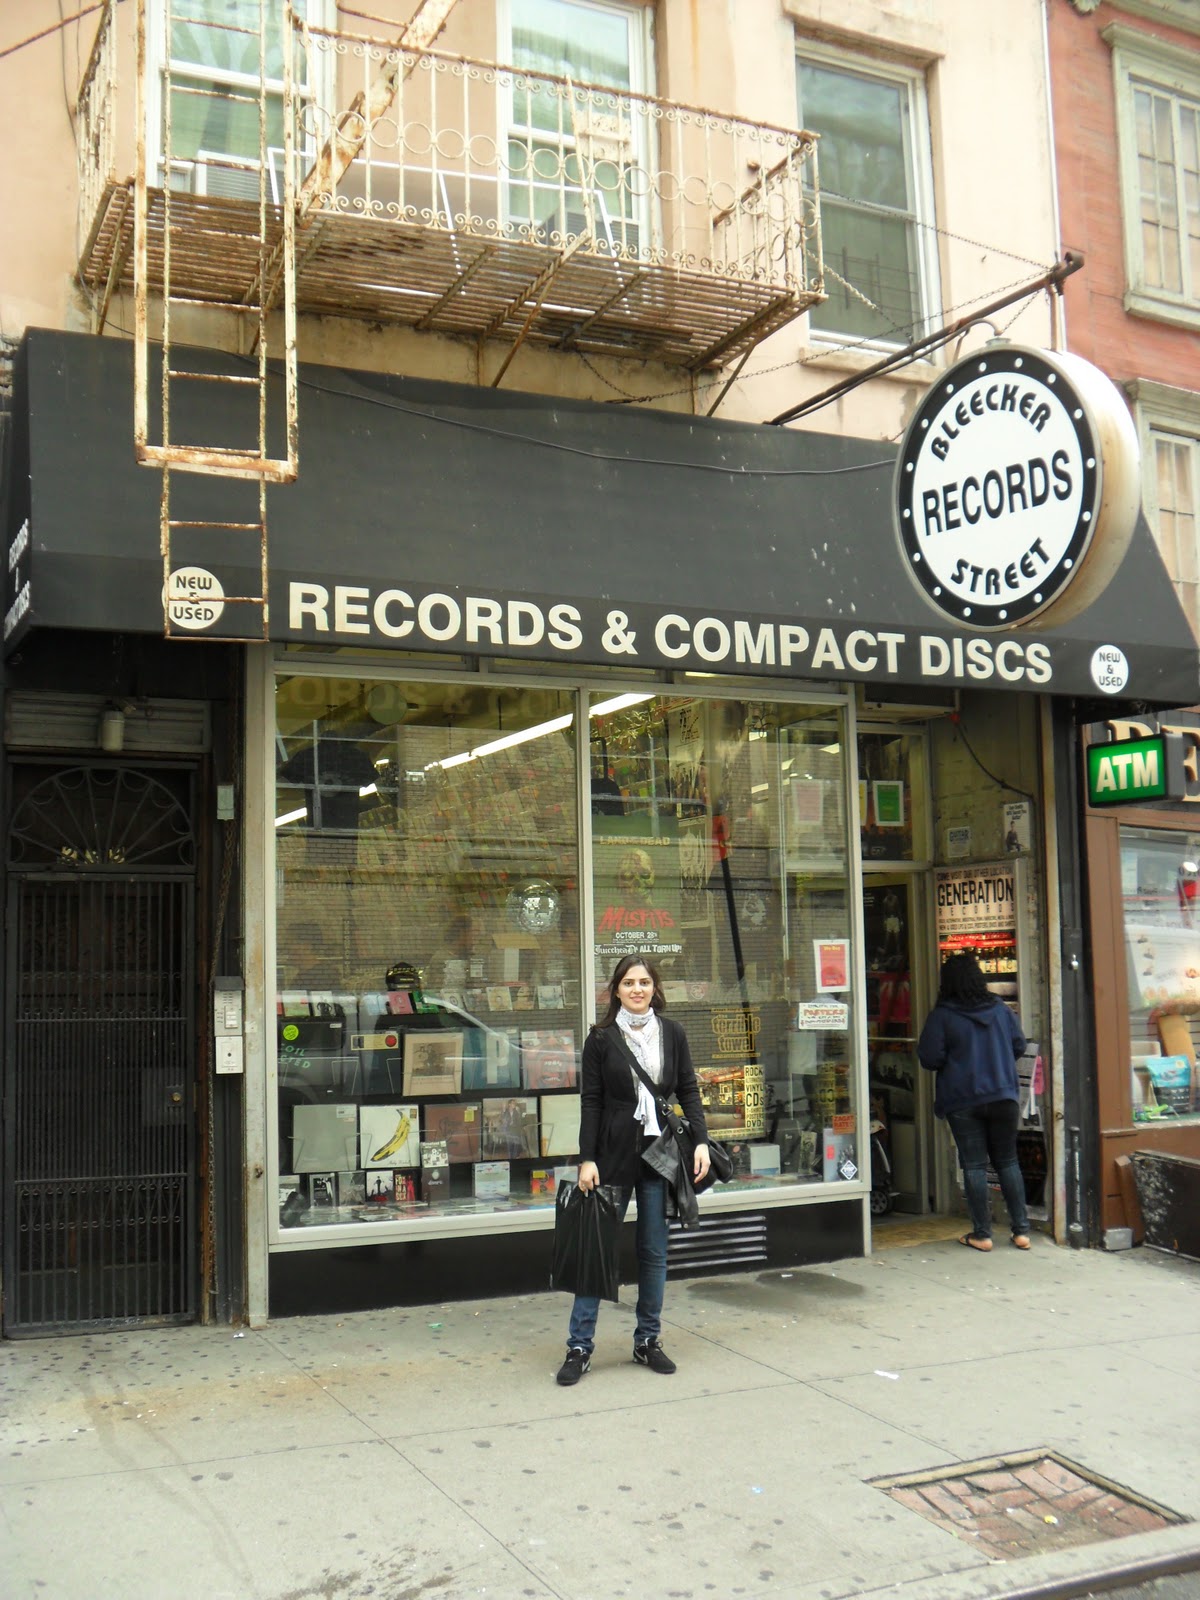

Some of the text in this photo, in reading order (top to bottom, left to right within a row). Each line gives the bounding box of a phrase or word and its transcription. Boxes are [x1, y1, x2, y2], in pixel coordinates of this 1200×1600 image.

[931, 383, 1051, 462] BLEECKER
[922, 449, 1073, 537] RECORDS
[950, 537, 1050, 596] STREET
[175, 575, 213, 590] NEW
[173, 606, 214, 621] USED
[289, 581, 1053, 684] RECORDS & COMPACT DISCS
[1099, 652, 1121, 663] NEW
[1106, 664, 1114, 674] &
[1099, 676, 1123, 687] USED
[1096, 750, 1159, 793] ATM
[937, 877, 1014, 907] GENERATION
[938, 902, 1015, 917] RECORDS
[615, 931, 645, 939] OCTOBER
[639, 945, 651, 953] ALL
[745, 1066, 764, 1077] ROCK
[745, 1083, 764, 1092] VINYL
[745, 1092, 764, 1107] CDs
